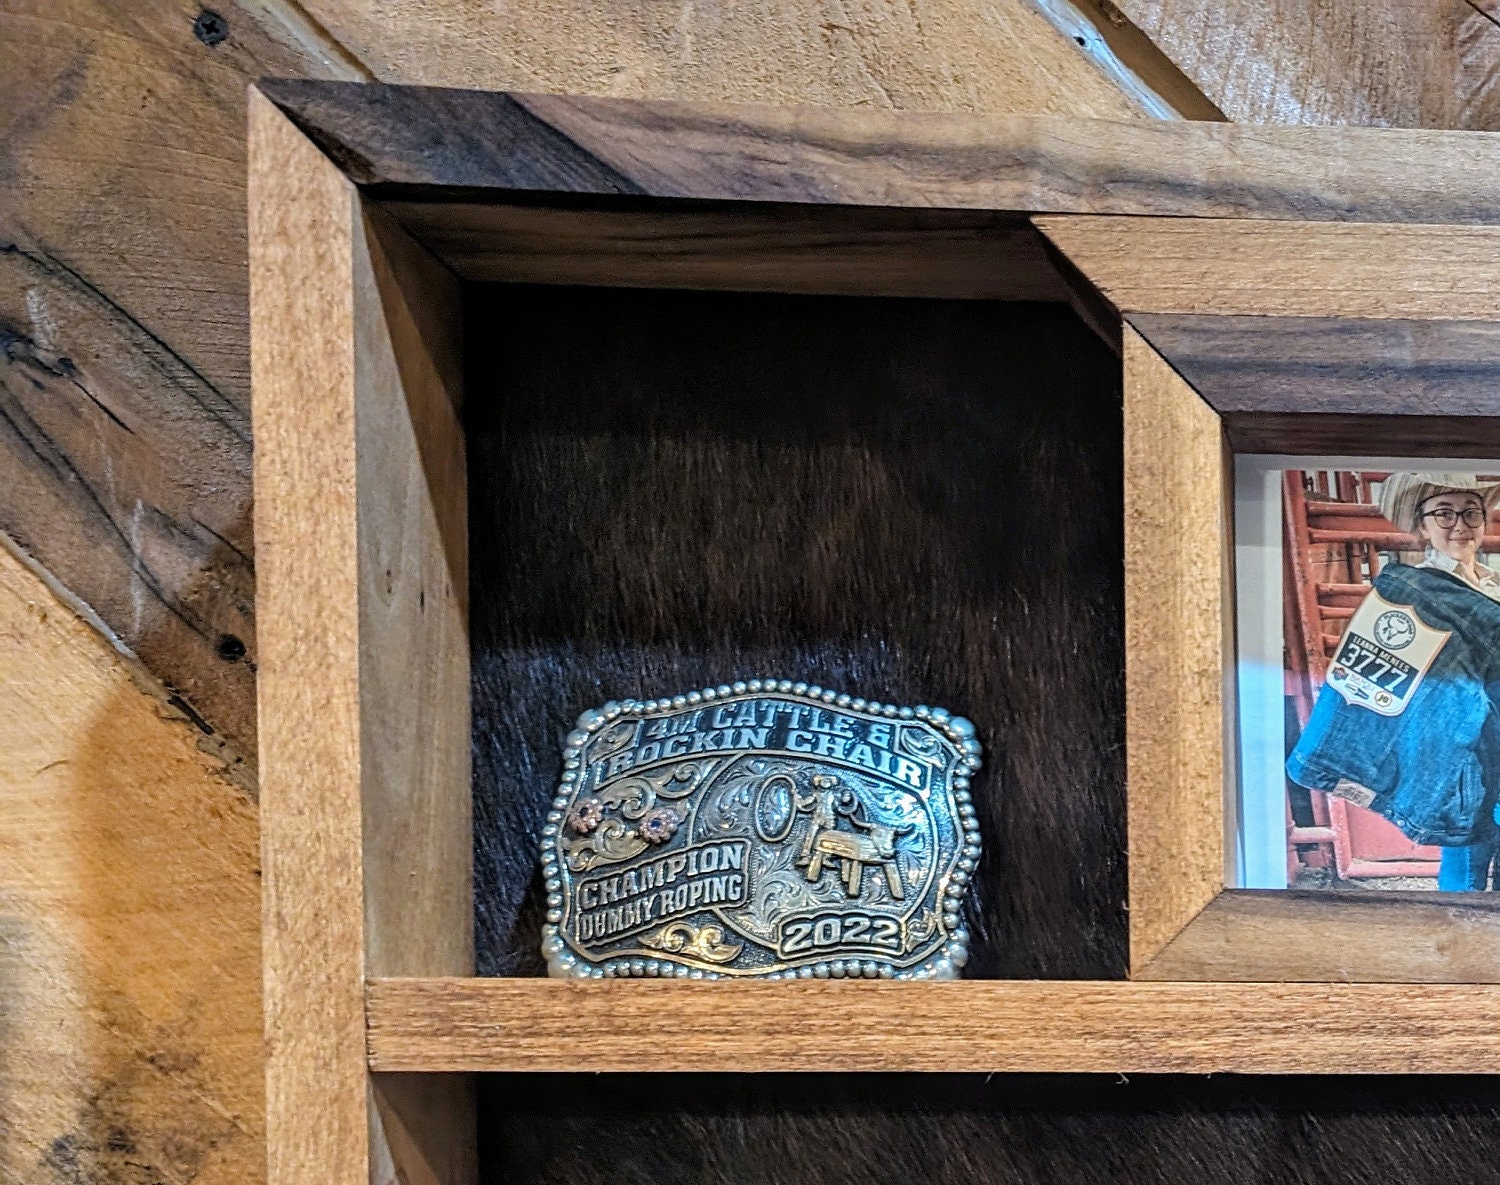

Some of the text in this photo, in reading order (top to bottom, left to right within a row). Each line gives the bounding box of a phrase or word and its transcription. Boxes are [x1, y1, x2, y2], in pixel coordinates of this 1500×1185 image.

[1340, 643, 1408, 692] 3777
[647, 700, 891, 750] 4M CATTLE &
[606, 727, 923, 786] ROCKIN CHAIR
[581, 844, 743, 910] CHAMPION
[580, 874, 742, 941] DUMMY ROPING
[783, 916, 899, 953] 2022
